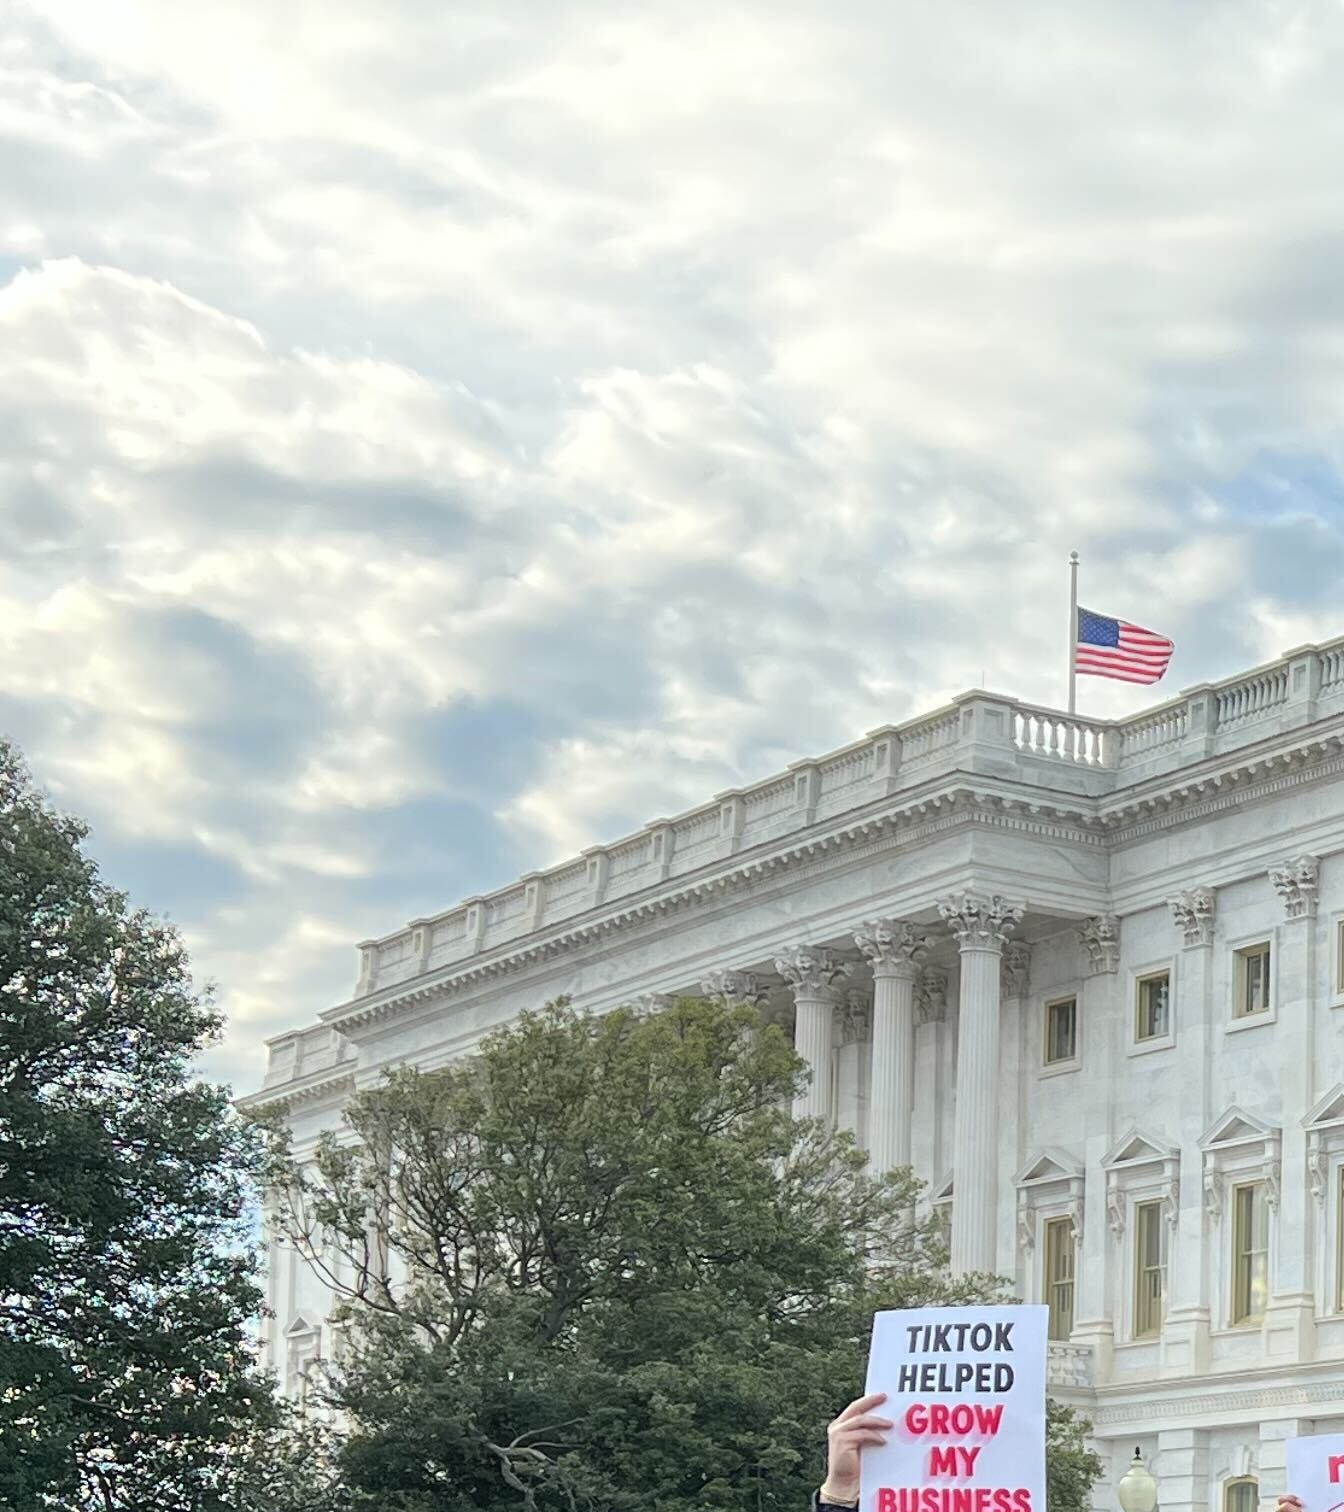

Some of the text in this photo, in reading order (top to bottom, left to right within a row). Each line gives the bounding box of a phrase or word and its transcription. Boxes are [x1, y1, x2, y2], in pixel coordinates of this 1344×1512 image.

[907, 1323, 1014, 1353] TIKTOK
[898, 1363, 1014, 1393] HELPED
[905, 1404, 1004, 1436] GROW
[929, 1447, 981, 1477] MY
